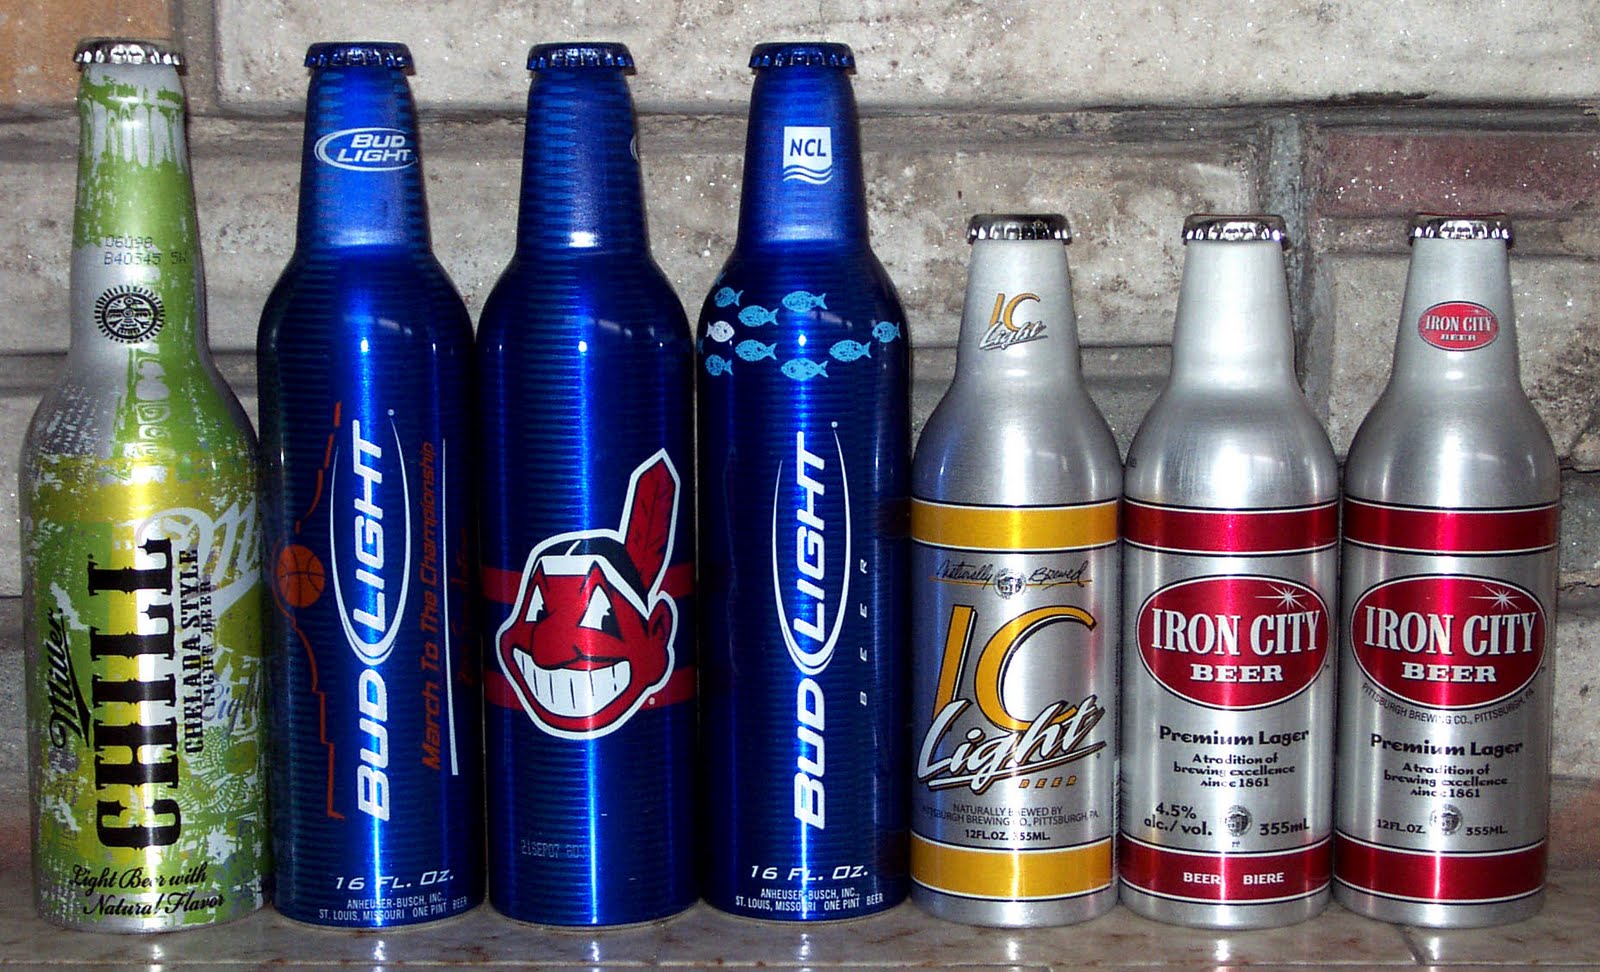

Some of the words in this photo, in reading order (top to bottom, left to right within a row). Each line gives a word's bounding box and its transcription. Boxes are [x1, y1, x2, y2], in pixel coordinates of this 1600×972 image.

[350, 134, 406, 148] BUD
[790, 138, 826, 157] NCL
[337, 148, 411, 162] LIGHT
[989, 293, 1041, 332] IC
[1425, 315, 1459, 331] IRON
[1463, 316, 1492, 332] CITY
[979, 321, 1048, 350] Light
[352, 419, 386, 632] LIGHT
[420, 441, 439, 587] Championship
[794, 431, 825, 642] LIGHT
[937, 559, 994, 590] Naturally
[1028, 560, 1089, 590] Brewed
[179, 549, 200, 628] STYLE
[200, 580, 212, 633] BEER
[420, 591, 439, 633] The
[1151, 608, 1240, 656] IRON
[1251, 610, 1320, 656] CITY
[1364, 605, 1454, 655] IRON
[1463, 612, 1536, 656] CITY
[420, 641, 439, 672] To
[931, 604, 1097, 732] IC
[49, 607, 91, 748] Miller
[1190, 663, 1283, 682] BEER
[1401, 661, 1496, 682] BEER
[88, 538, 182, 849] CHILL
[182, 635, 203, 753] CHELADA
[1361, 682, 1407, 717] PITTSBURGH
[421, 680, 441, 770] March
[1160, 725, 1254, 745] Premium
[1259, 729, 1309, 746] Lager
[357, 669, 390, 821] BUD
[794, 678, 825, 830] BUD
[917, 694, 1106, 795] Light
[1371, 734, 1465, 756] Premium
[1470, 741, 1523, 758] Lager
[1173, 762, 1225, 777] brewing
[1230, 764, 1295, 776] excellence
[1192, 754, 1201, 763] A
[1203, 754, 1263, 764] tradition
[1265, 752, 1278, 764] of
[1402, 762, 1412, 771] A
[1478, 764, 1490, 775] of
[1018, 776, 1077, 789] BEER
[1200, 779, 1236, 788] since
[1239, 778, 1269, 788] 1861
[1384, 770, 1436, 787] brewing
[1441, 777, 1508, 787] excellence
[1449, 789, 1480, 798] 1861
[953, 803, 1006, 816] NATURALLY
[1051, 806, 1063, 815] BY
[966, 815, 1010, 827] BREWING
[1156, 802, 1197, 820] 4.5%
[1181, 821, 1213, 836] vol.
[1259, 818, 1310, 836] 355mL
[69, 864, 117, 896] Light
[119, 867, 166, 889] Beer
[170, 861, 208, 887] with
[336, 877, 365, 890] 16
[751, 866, 778, 880] 16
[788, 868, 823, 881] FL.
[1183, 872, 1221, 884] BEER
[1243, 872, 1285, 885] BIERE
[84, 891, 165, 916] Natural
[165, 890, 225, 914] Flavor
[319, 909, 331, 919] ST.
[333, 910, 360, 921] LOUIS,
[363, 910, 405, 921] MISSOURI
[412, 907, 428, 918] ONE
[430, 903, 447, 914] PINT
[453, 896, 468, 910] BEER
[735, 896, 746, 906] ST.
[748, 898, 773, 911] LOUIS,
[824, 901, 841, 911] ONE
[843, 898, 859, 909] PINT
[866, 893, 883, 906] BEER
